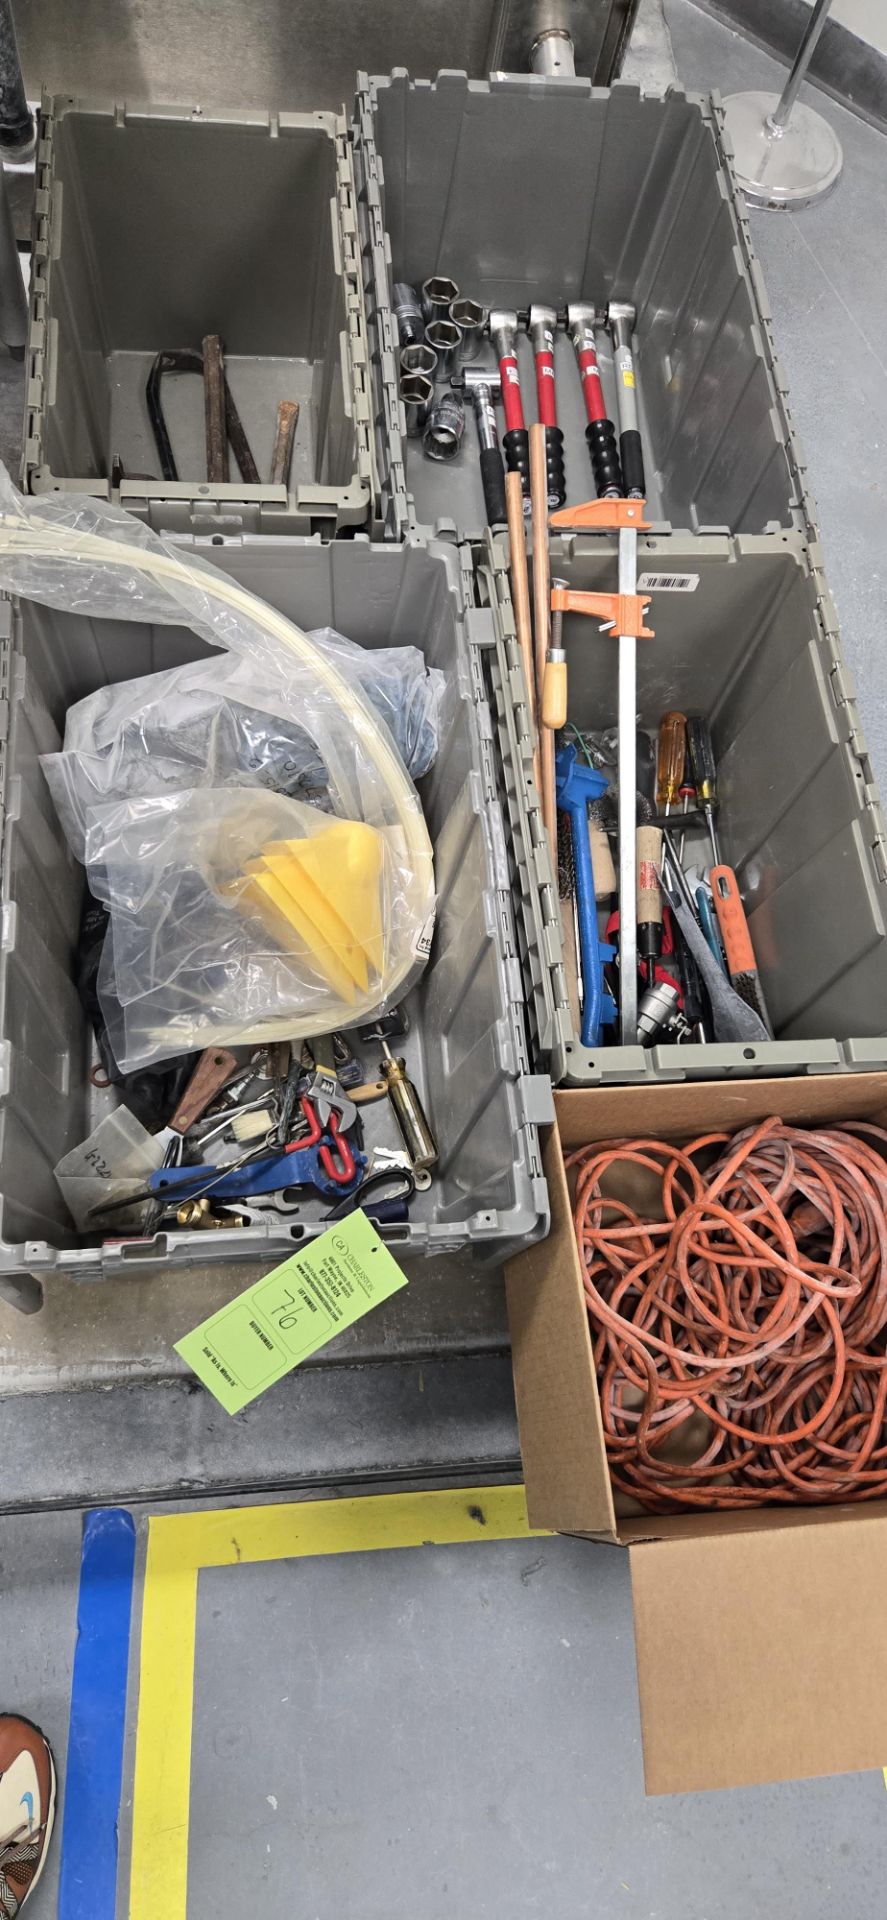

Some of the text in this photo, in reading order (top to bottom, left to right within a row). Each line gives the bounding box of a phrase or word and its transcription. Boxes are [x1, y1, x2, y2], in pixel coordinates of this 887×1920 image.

[334, 1239, 346, 1251] CA
[320, 1258, 329, 1267] Fort
[345, 1253, 376, 1292] CHARLESTON
[271, 1289, 303, 1330] 76
[297, 1287, 318, 1313] LOT NUMBER
[248, 1319, 274, 1351] BUYER NUMBER
